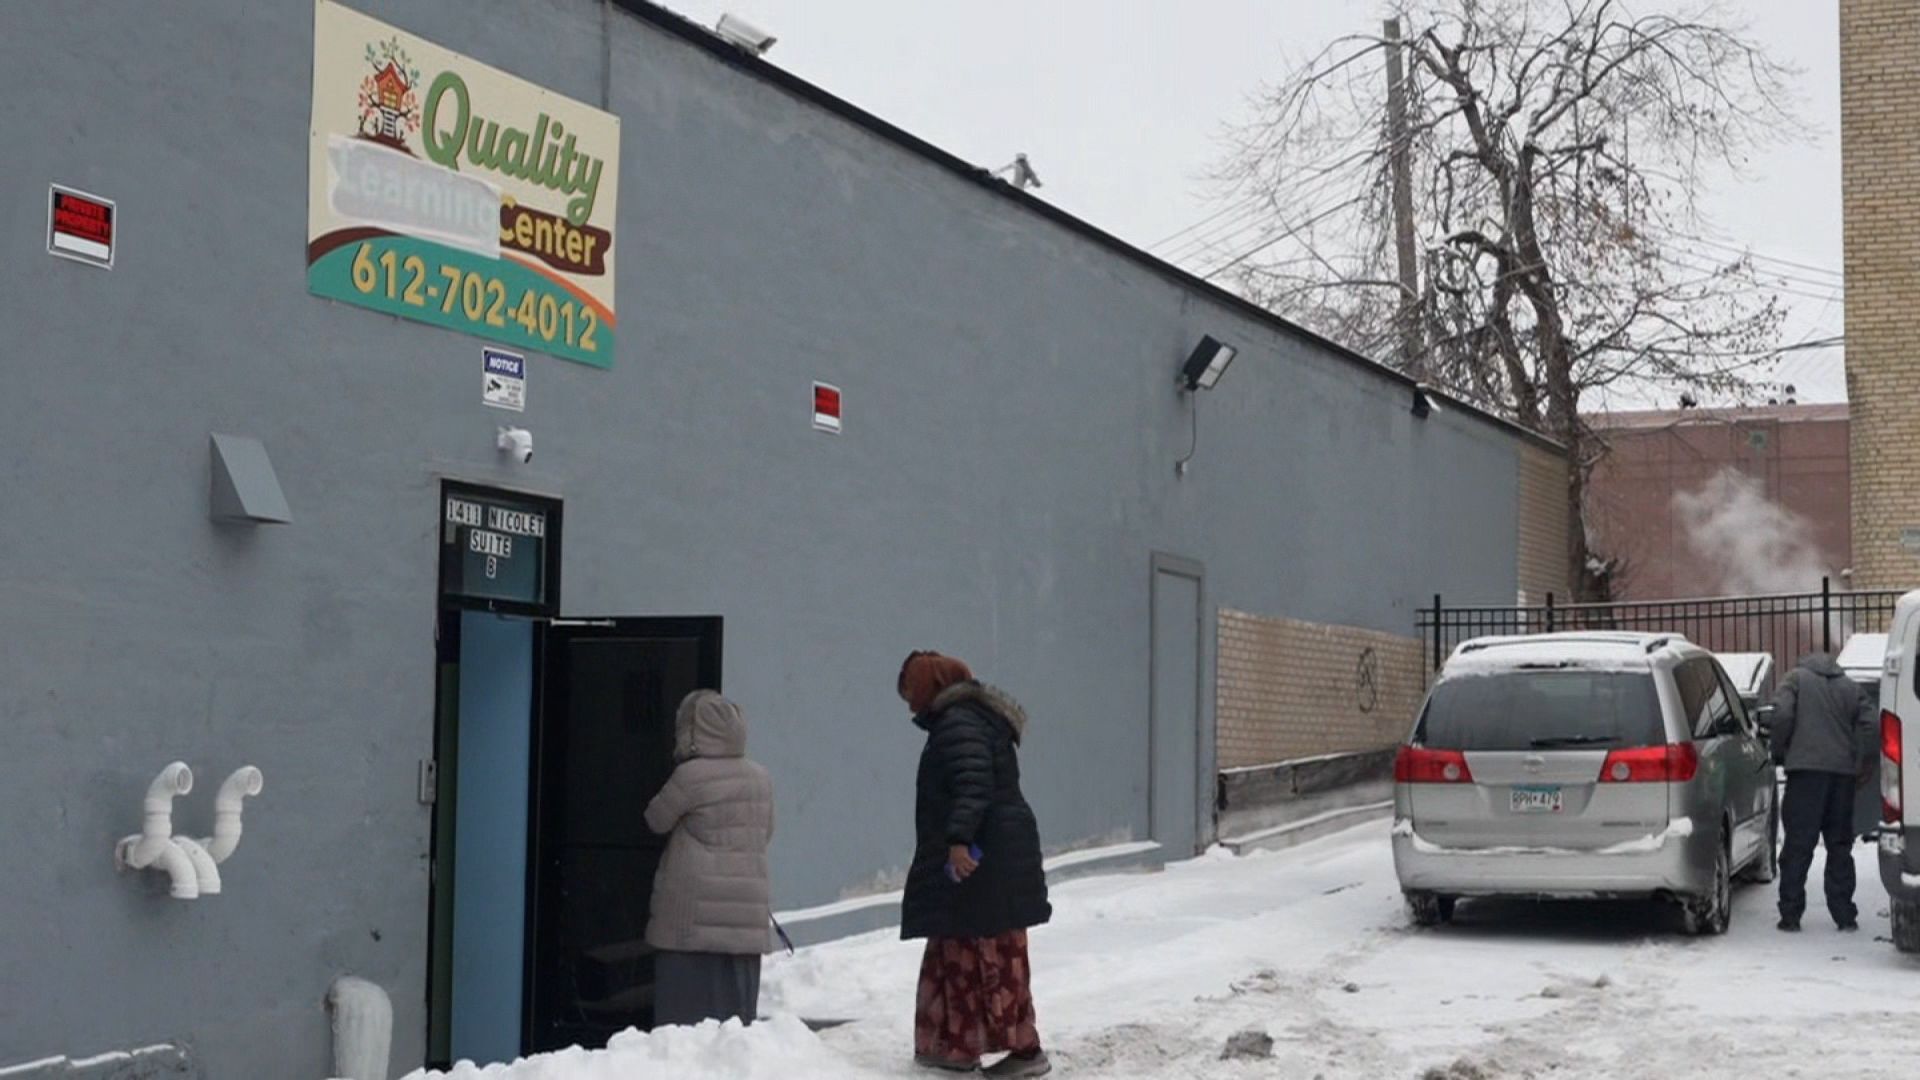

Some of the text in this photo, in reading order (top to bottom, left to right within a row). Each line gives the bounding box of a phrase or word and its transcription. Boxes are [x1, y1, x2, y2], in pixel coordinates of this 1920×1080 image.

[422, 71, 603, 226] Quality
[499, 196, 597, 266] Center
[352, 243, 597, 350] 612-702-4012
[489, 356, 518, 373] NOTICE
[449, 501, 543, 535] 1411 NICOLET
[471, 531, 510, 556] SUITE
[488, 557, 496, 576] B
